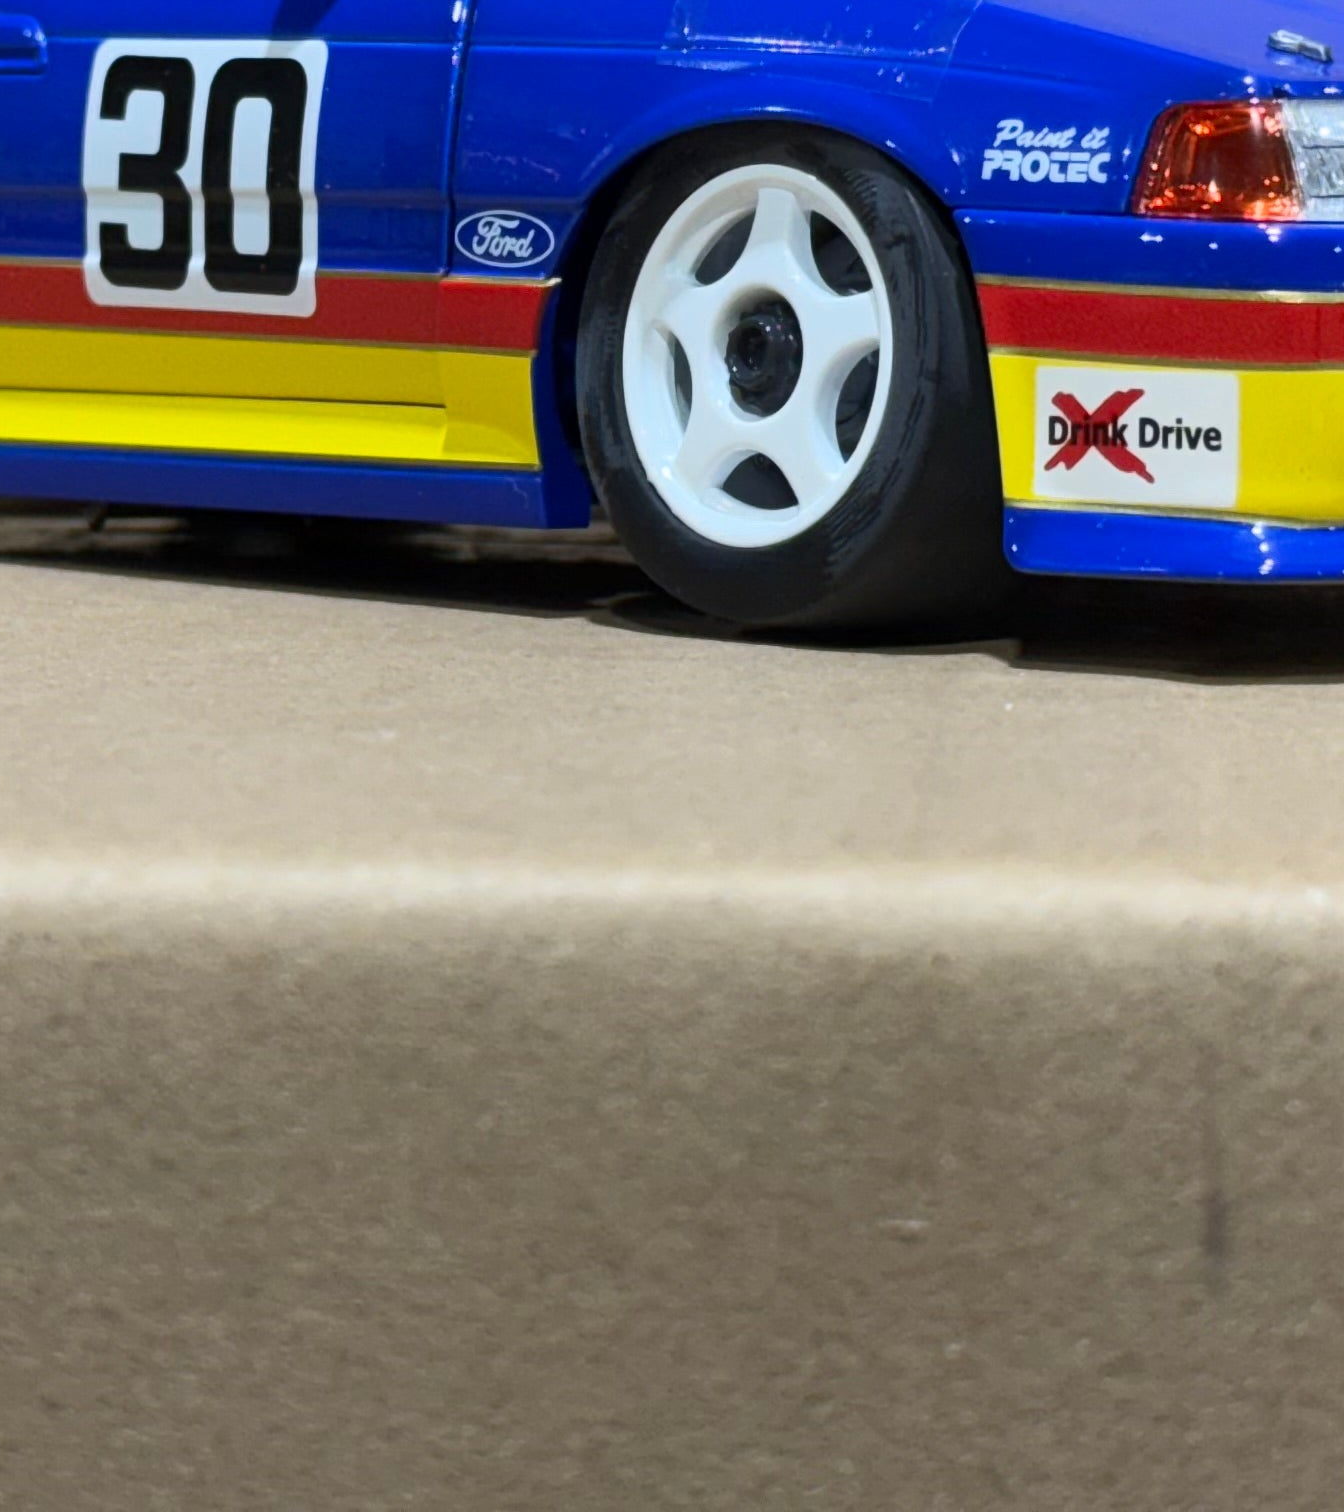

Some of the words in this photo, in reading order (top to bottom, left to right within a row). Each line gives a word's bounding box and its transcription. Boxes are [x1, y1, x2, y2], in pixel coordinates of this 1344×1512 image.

[993, 118, 1074, 148] Paint
[1080, 124, 1109, 148] it
[100, 55, 307, 295] 30
[981, 149, 1111, 184] PROTEC
[471, 215, 534, 259] Ford
[1047, 414, 1127, 449] Drink
[1137, 416, 1223, 452] Drive
